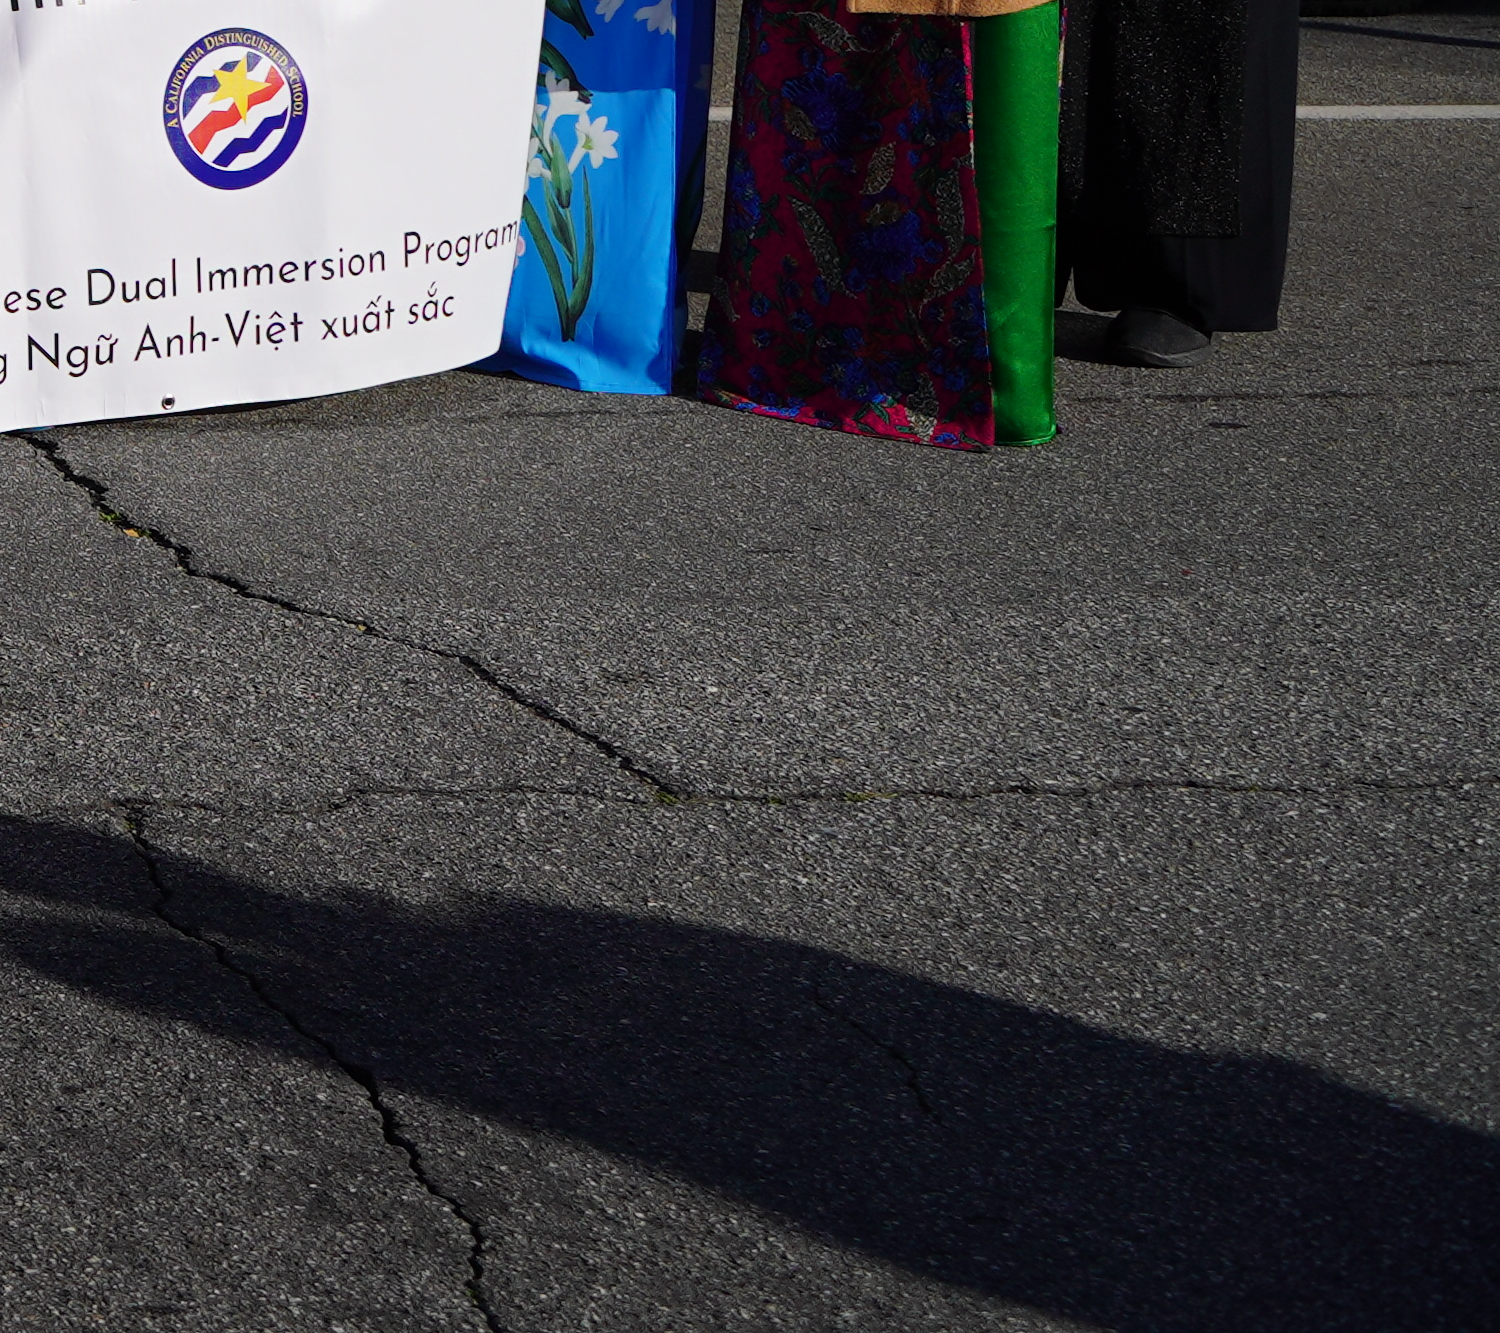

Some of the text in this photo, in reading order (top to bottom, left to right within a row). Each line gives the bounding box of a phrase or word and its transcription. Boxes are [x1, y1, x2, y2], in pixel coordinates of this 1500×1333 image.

[165, 47, 204, 114] CALIFORNIA
[204, 32, 288, 68] DISTINGUISHED
[286, 66, 303, 118] SCHOOL
[87, 258, 176, 306] Dual
[196, 247, 386, 294] Immersion
[404, 221, 517, 268] Program
[28, 333, 118, 377] Ngữ
[134, 309, 304, 362] Anh-Việt
[322, 295, 395, 340] xuất
[408, 282, 454, 324] sắc
